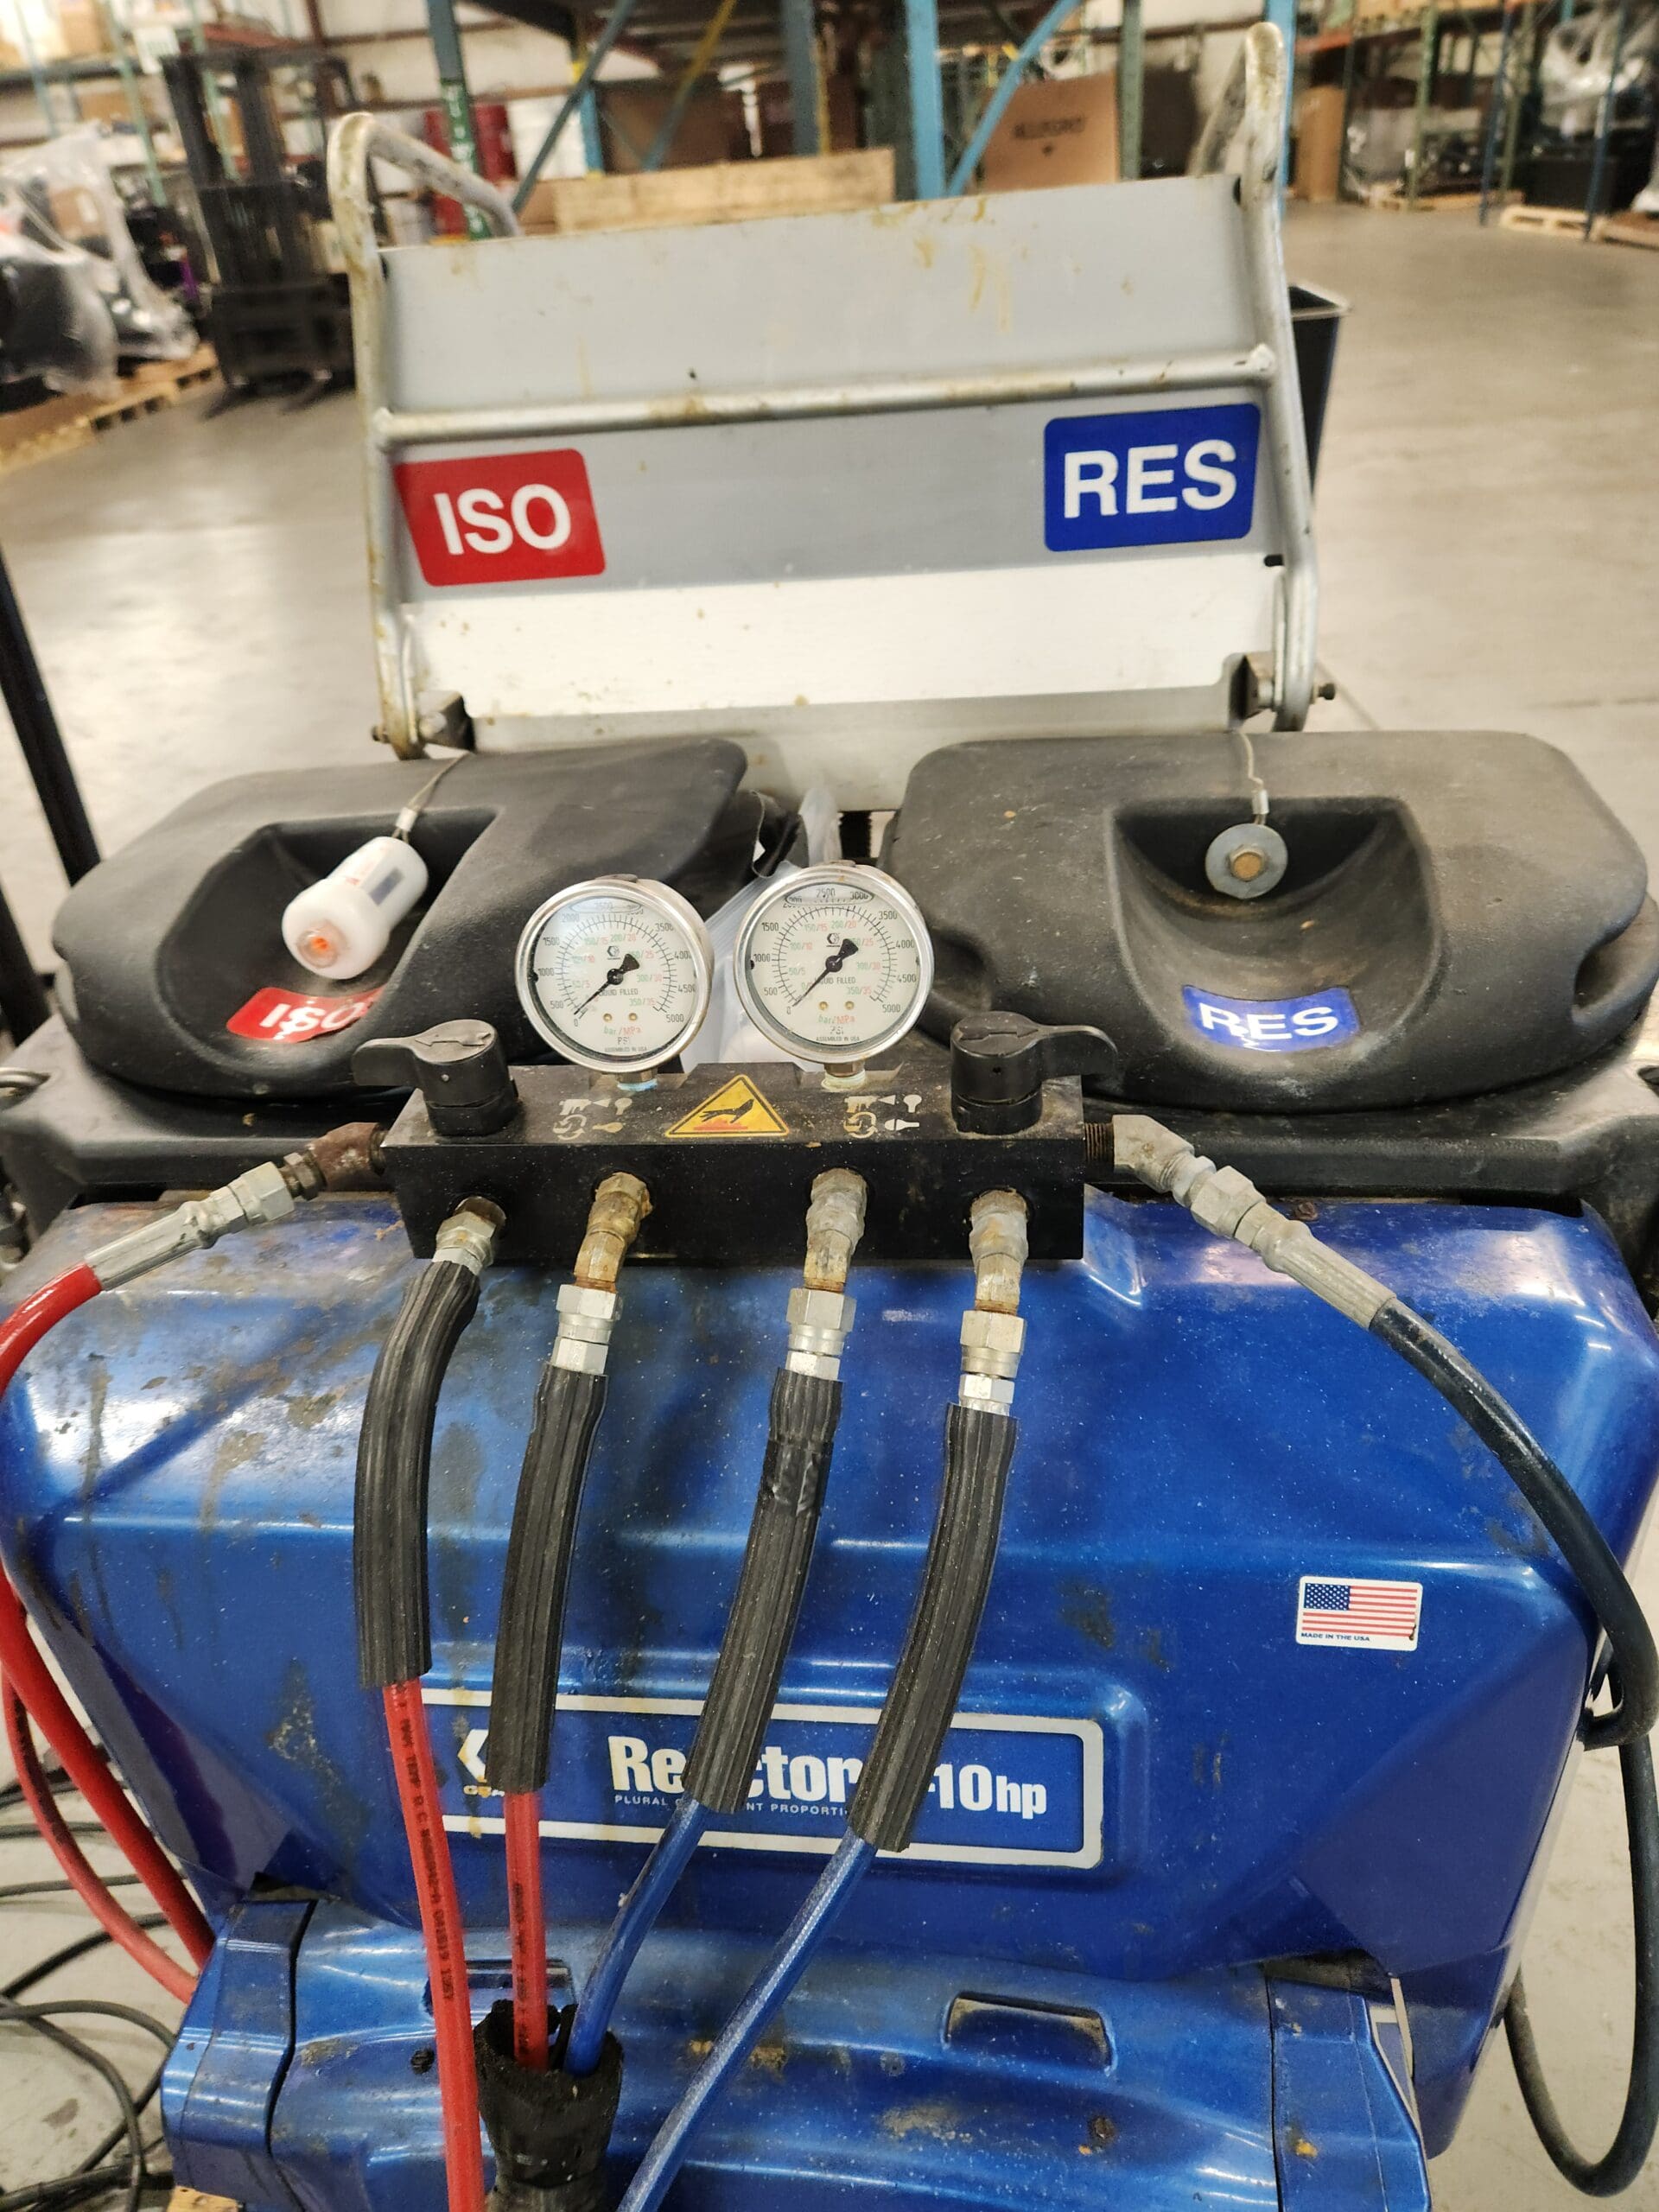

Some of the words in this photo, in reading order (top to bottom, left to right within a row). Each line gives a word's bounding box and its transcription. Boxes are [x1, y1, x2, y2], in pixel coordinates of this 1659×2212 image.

[1065, 439, 1237, 518] RES
[434, 484, 572, 556] ISO
[879, 911, 898, 920] 3500
[762, 922, 779, 931] 1500
[543, 937, 560, 946] 1500
[895, 940, 915, 949] 4000
[753, 954, 771, 963] 1000
[538, 968, 555, 976] 1000
[764, 987, 778, 996] 500
[550, 1001, 564, 1009] 500
[882, 1004, 901, 1013] 5000
[786, 1006, 791, 1014] 0
[260, 1002, 366, 1037] ISO
[574, 1018, 579, 1027] 0
[666, 1014, 684, 1023] 5000
[1198, 1002, 1339, 1040] RES
[614, 1795, 668, 1807] PLURAL
